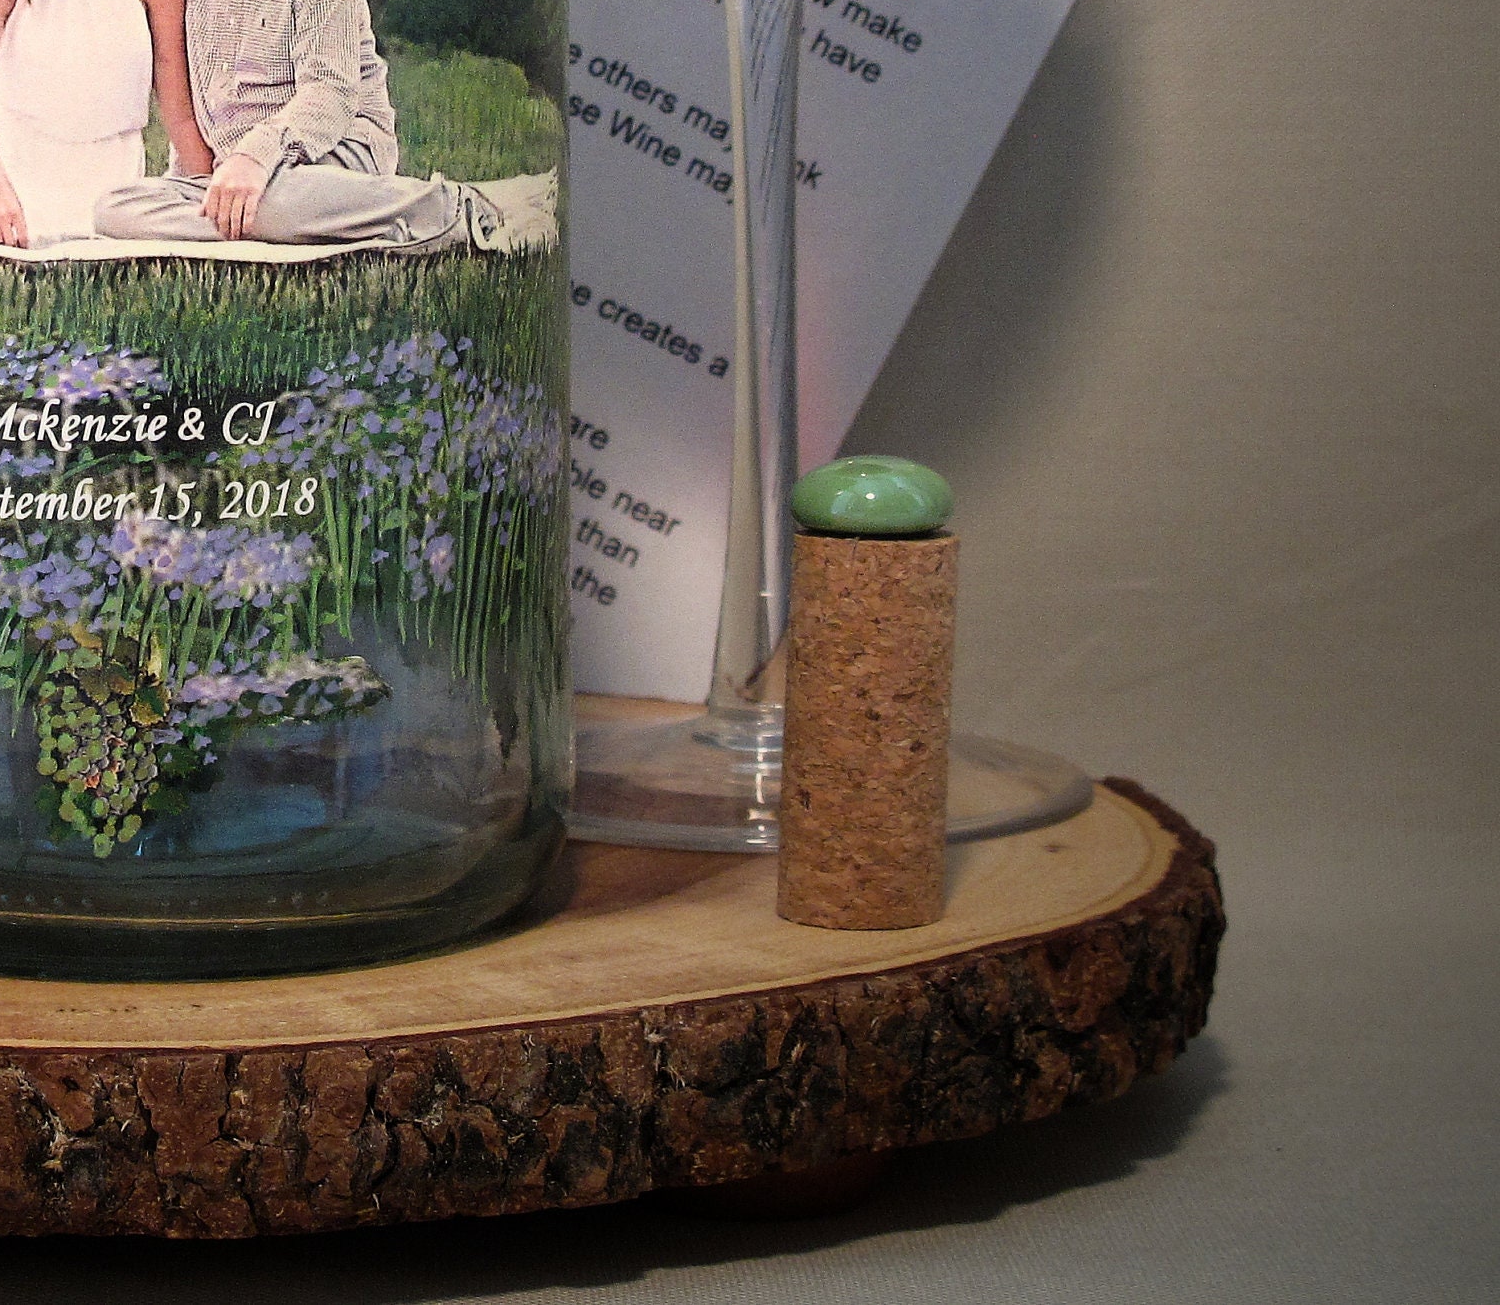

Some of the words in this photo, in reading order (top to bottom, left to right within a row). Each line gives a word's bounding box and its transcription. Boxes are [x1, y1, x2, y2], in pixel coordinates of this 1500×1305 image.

[842, 0, 923, 55] make
[809, 28, 883, 84] have
[588, 56, 678, 116] others
[609, 109, 683, 167] Wine
[598, 297, 704, 365] creates
[708, 355, 731, 379] a
[178, 407, 206, 443] &
[222, 400, 277, 446] CJ
[149, 481, 204, 529] 15,
[218, 477, 318, 521] 2018
[612, 491, 683, 537] near
[576, 517, 640, 569] than
[570, 564, 618, 606] the
